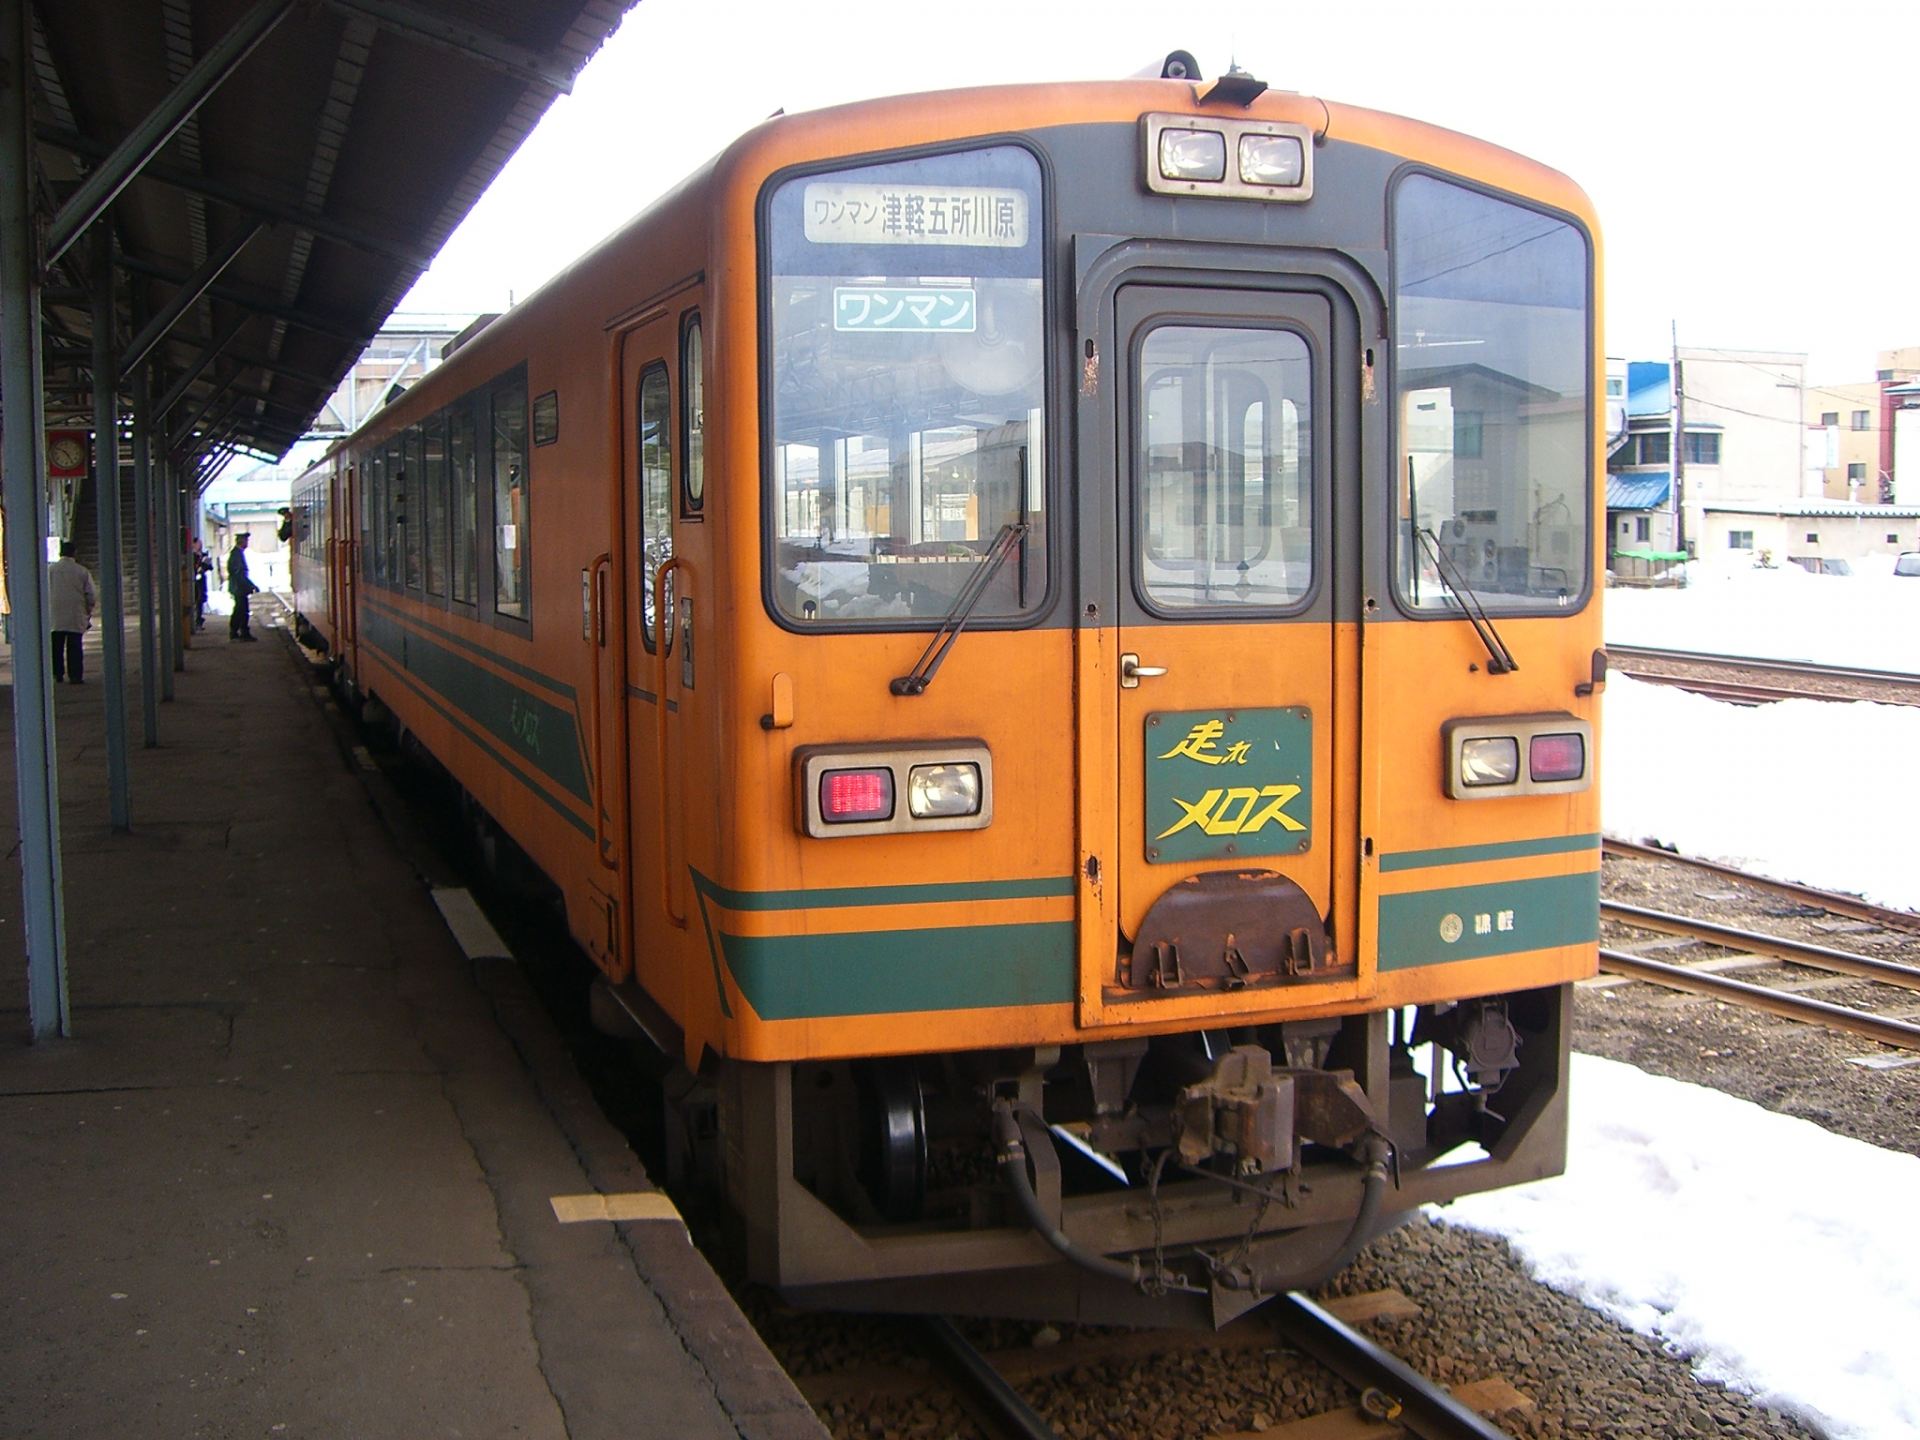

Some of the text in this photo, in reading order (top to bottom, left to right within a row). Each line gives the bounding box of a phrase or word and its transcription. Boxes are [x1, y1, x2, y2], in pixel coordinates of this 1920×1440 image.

[813, 192, 1016, 240] ワンマン 津軽五所川原
[839, 293, 970, 327] ワンマン
[1157, 719, 1252, 765] 走れ
[1155, 784, 1307, 840] メロス
